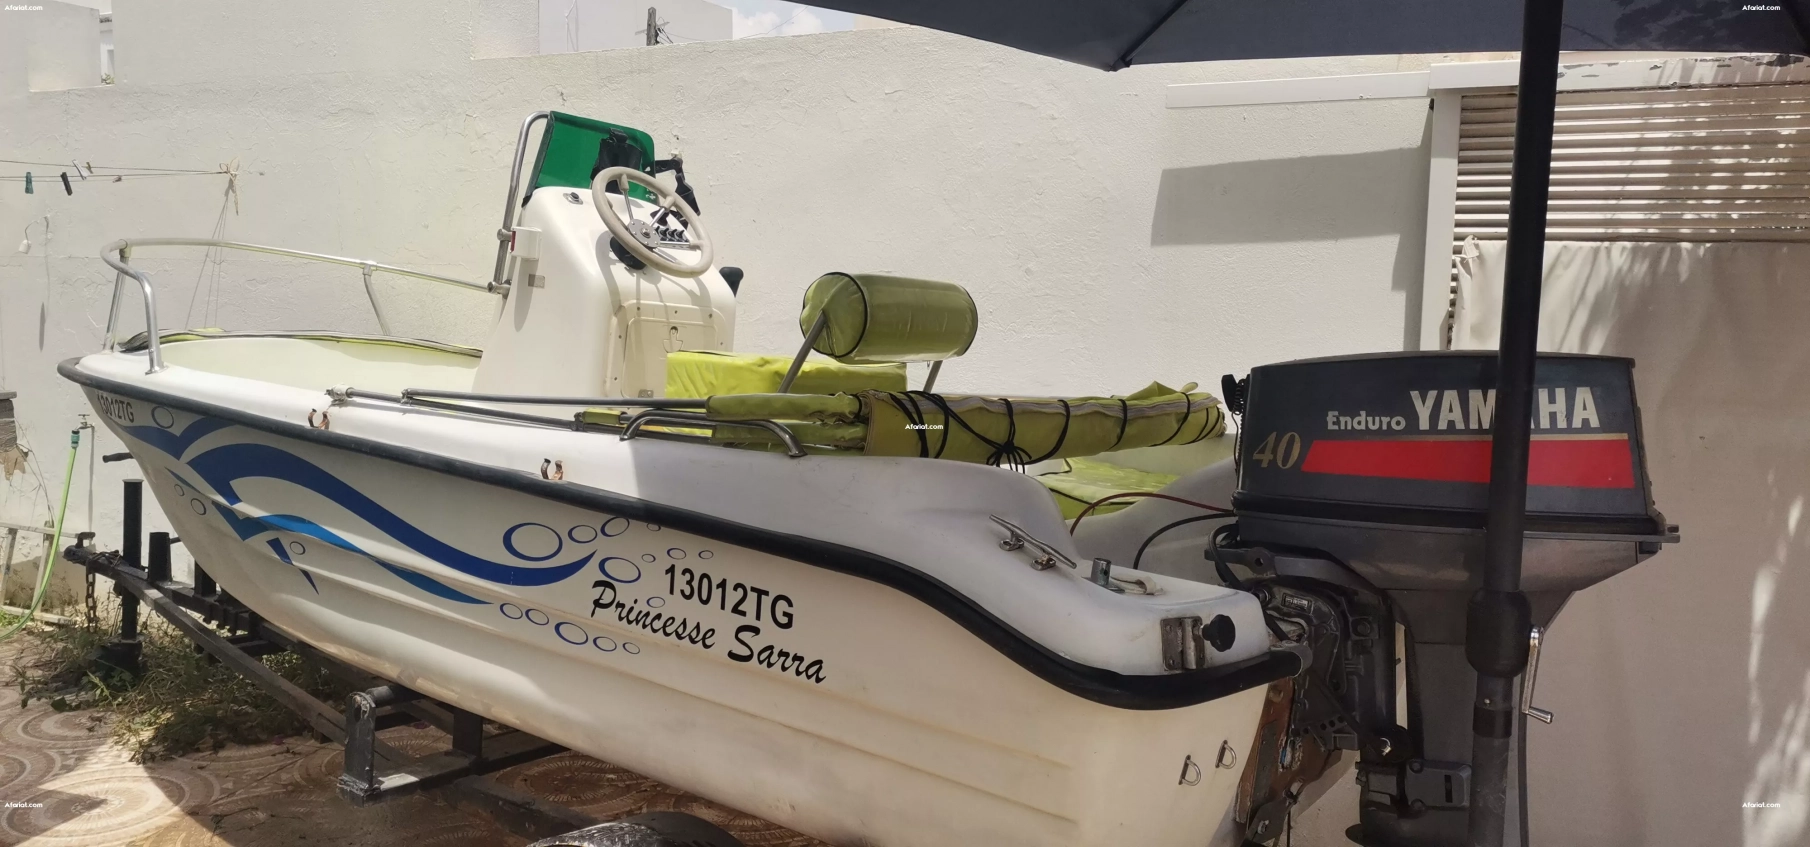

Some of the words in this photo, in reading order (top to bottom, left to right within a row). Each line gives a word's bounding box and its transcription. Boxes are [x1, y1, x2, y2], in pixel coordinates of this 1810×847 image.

[1326, 410, 1406, 431] Enduro
[1410, 387, 1600, 430] YAMHA
[1252, 431, 1302, 470] 40
[665, 564, 794, 629] 13012TG
[590, 580, 716, 649] Princesse
[727, 624, 827, 684] Sarra
